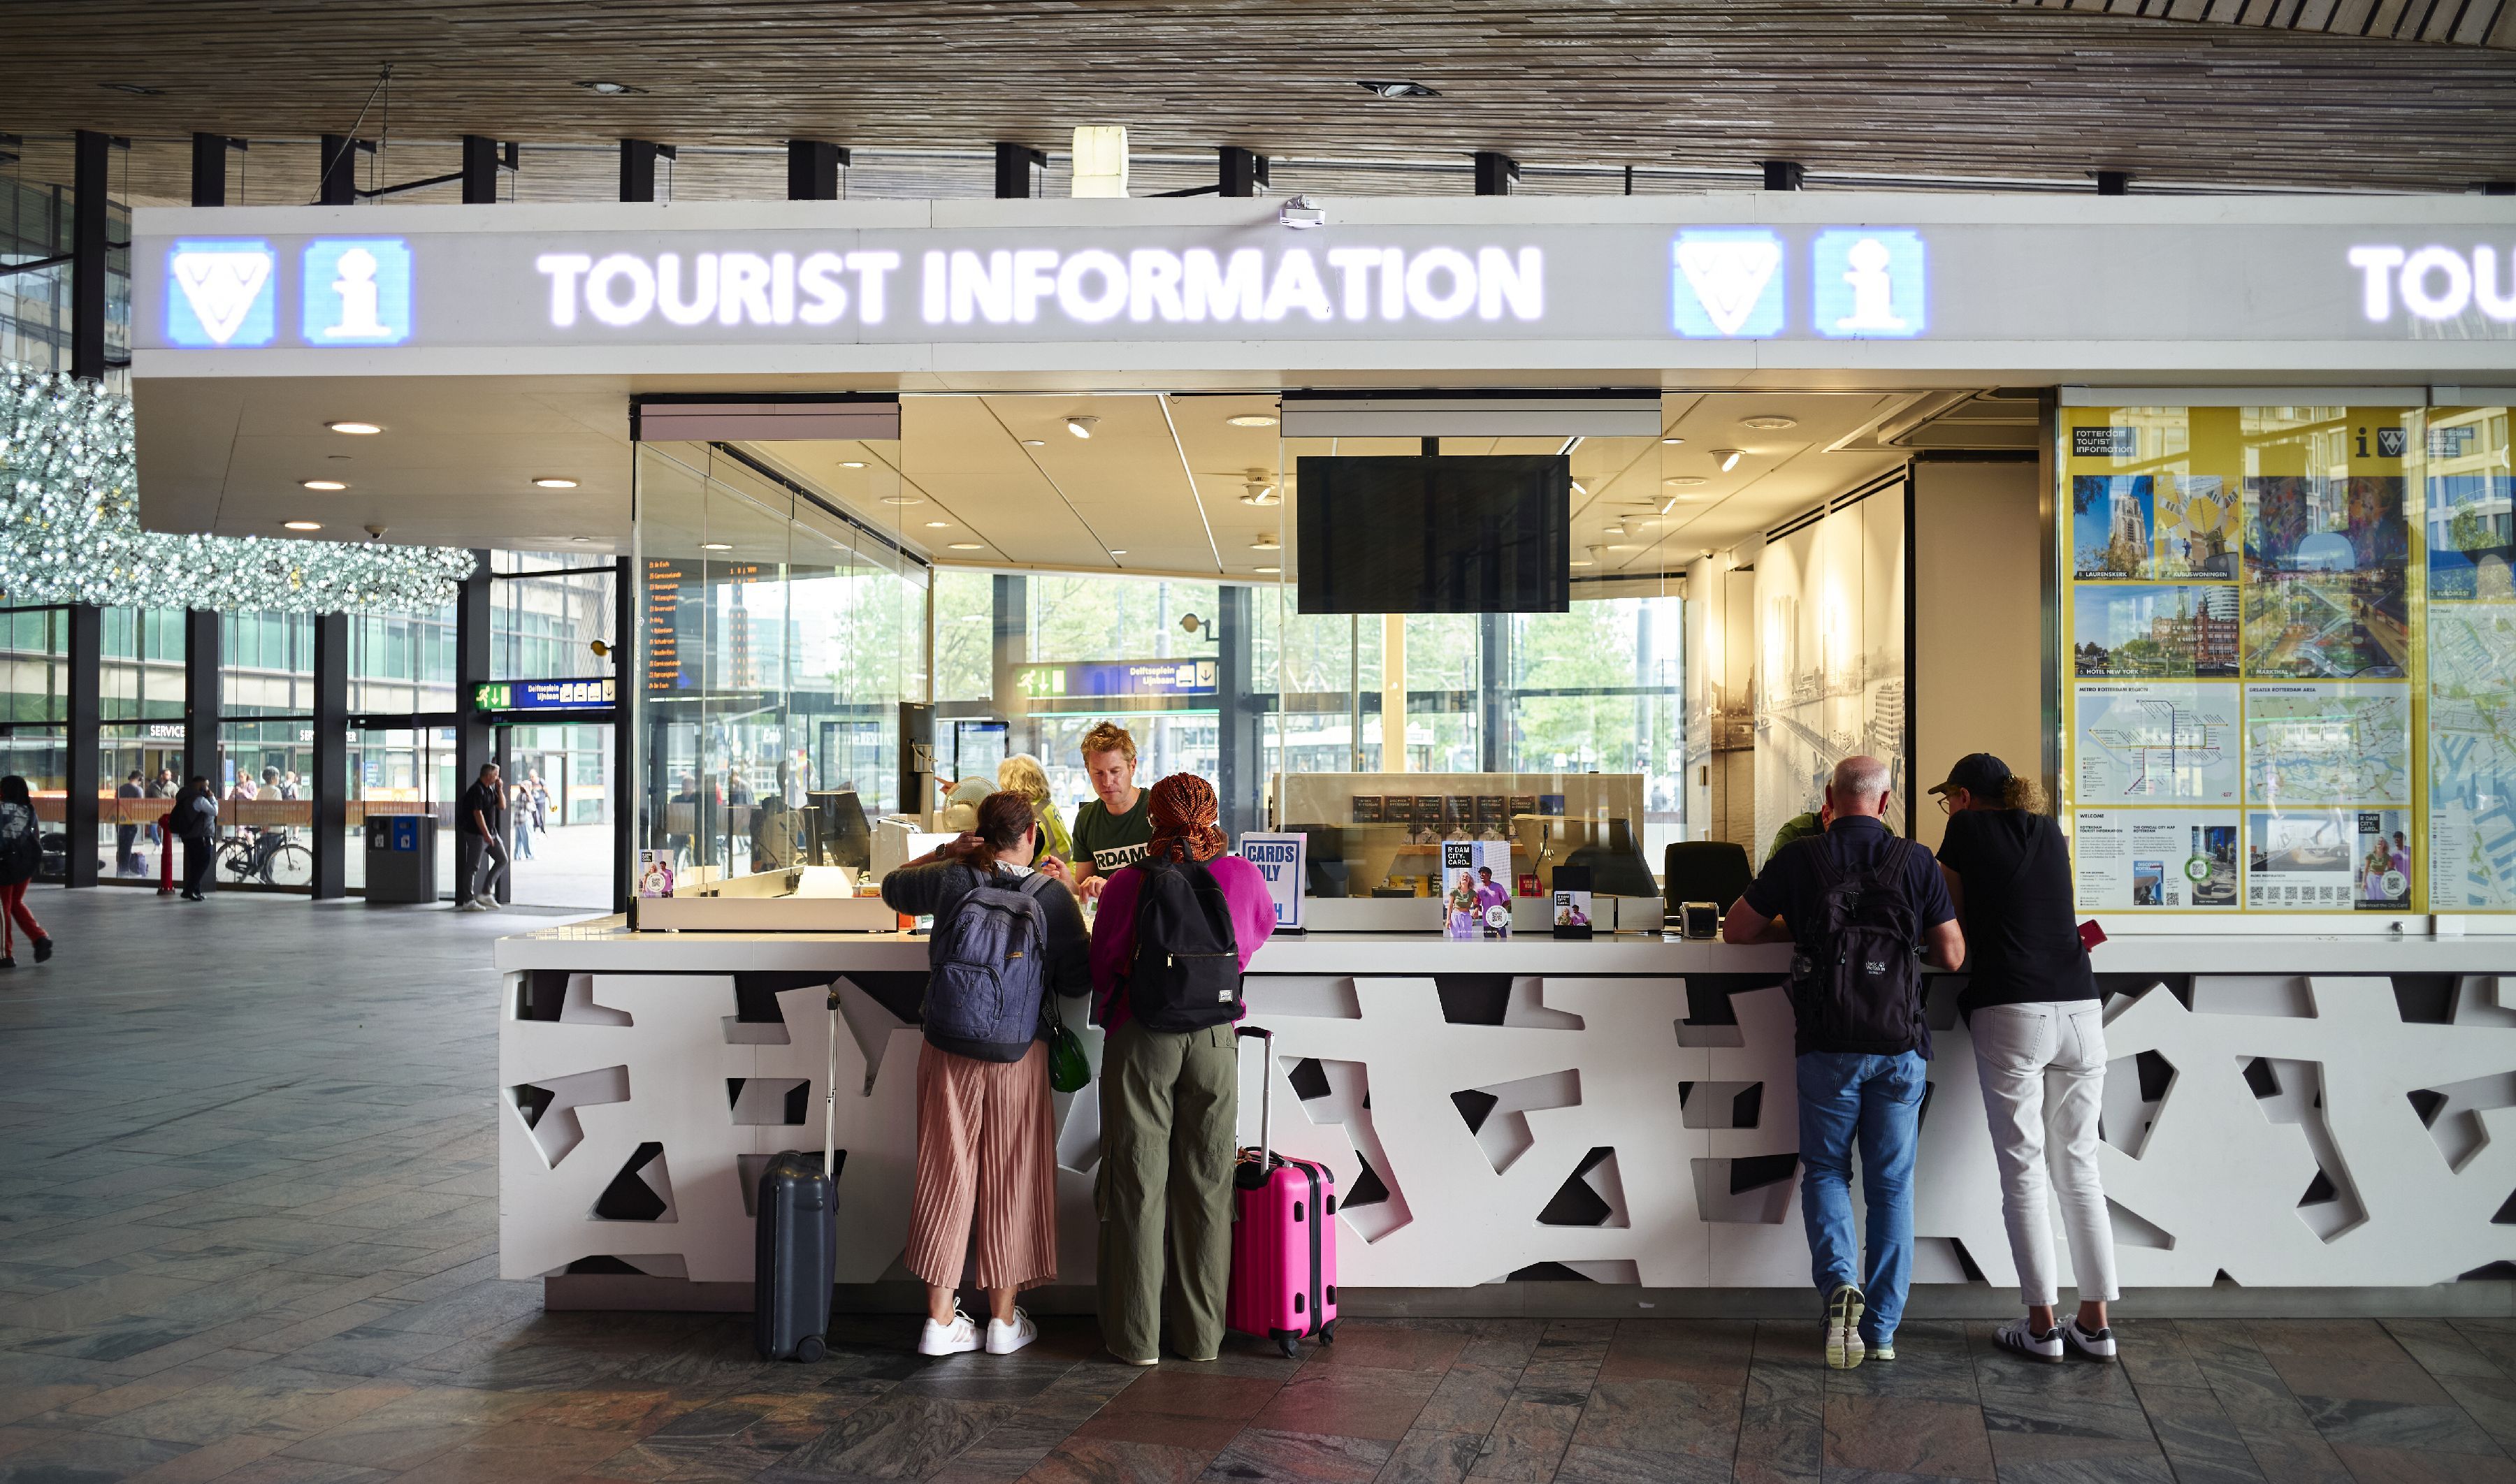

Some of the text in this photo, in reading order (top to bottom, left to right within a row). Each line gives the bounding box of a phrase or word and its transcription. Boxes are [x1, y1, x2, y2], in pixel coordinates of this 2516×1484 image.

[536, 246, 1542, 326] TOURIST INFORMATION
[2348, 245, 2516, 323] TOU
[1129, 665, 1175, 676] Delftseplein
[150, 725, 185, 738] SERVICE
[1095, 846, 1147, 868] RDAM
[1248, 845, 1294, 863] CARDS
[1257, 864, 1281, 882] NLY
